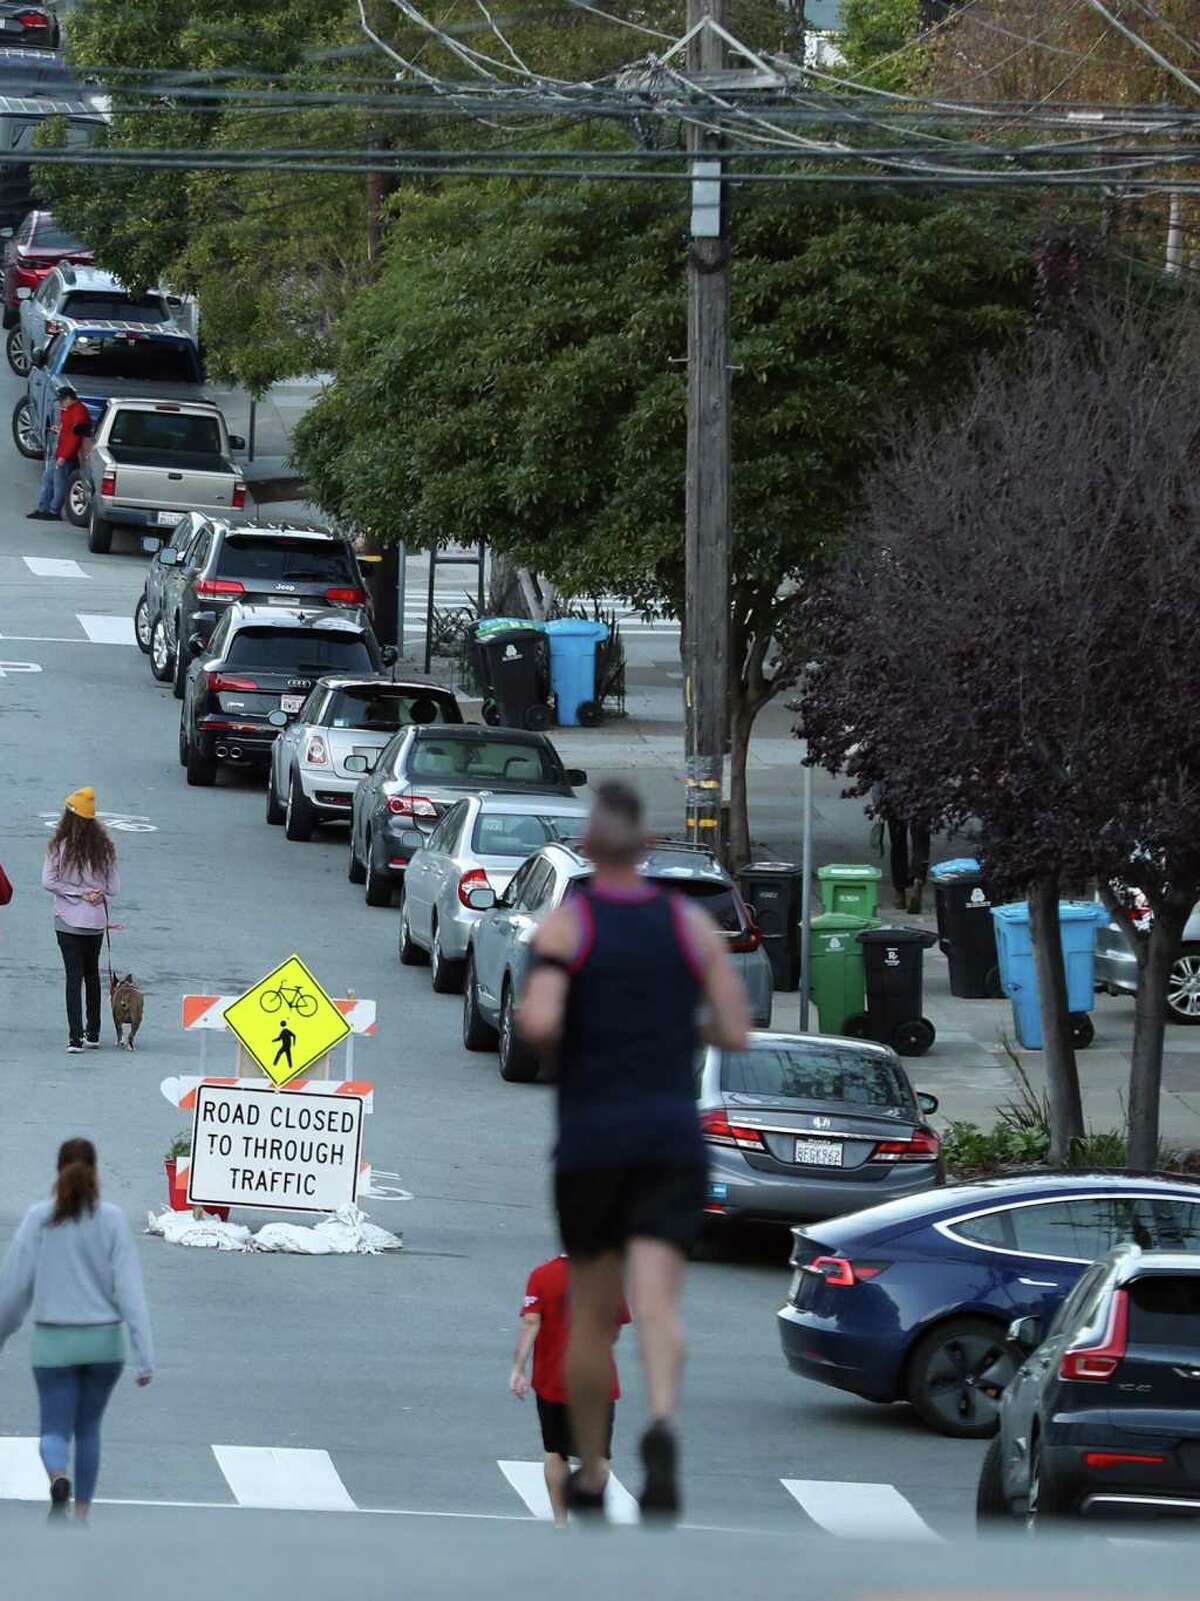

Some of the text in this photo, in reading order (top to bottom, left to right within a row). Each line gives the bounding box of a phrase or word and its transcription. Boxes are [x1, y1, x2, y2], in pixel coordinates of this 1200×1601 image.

[275, 583, 295, 592] Jeep
[203, 1101, 354, 1133] ROAD CLOSED
[208, 1134, 344, 1165] TO THROUGH
[229, 1168, 316, 1196] TRAFFIC
